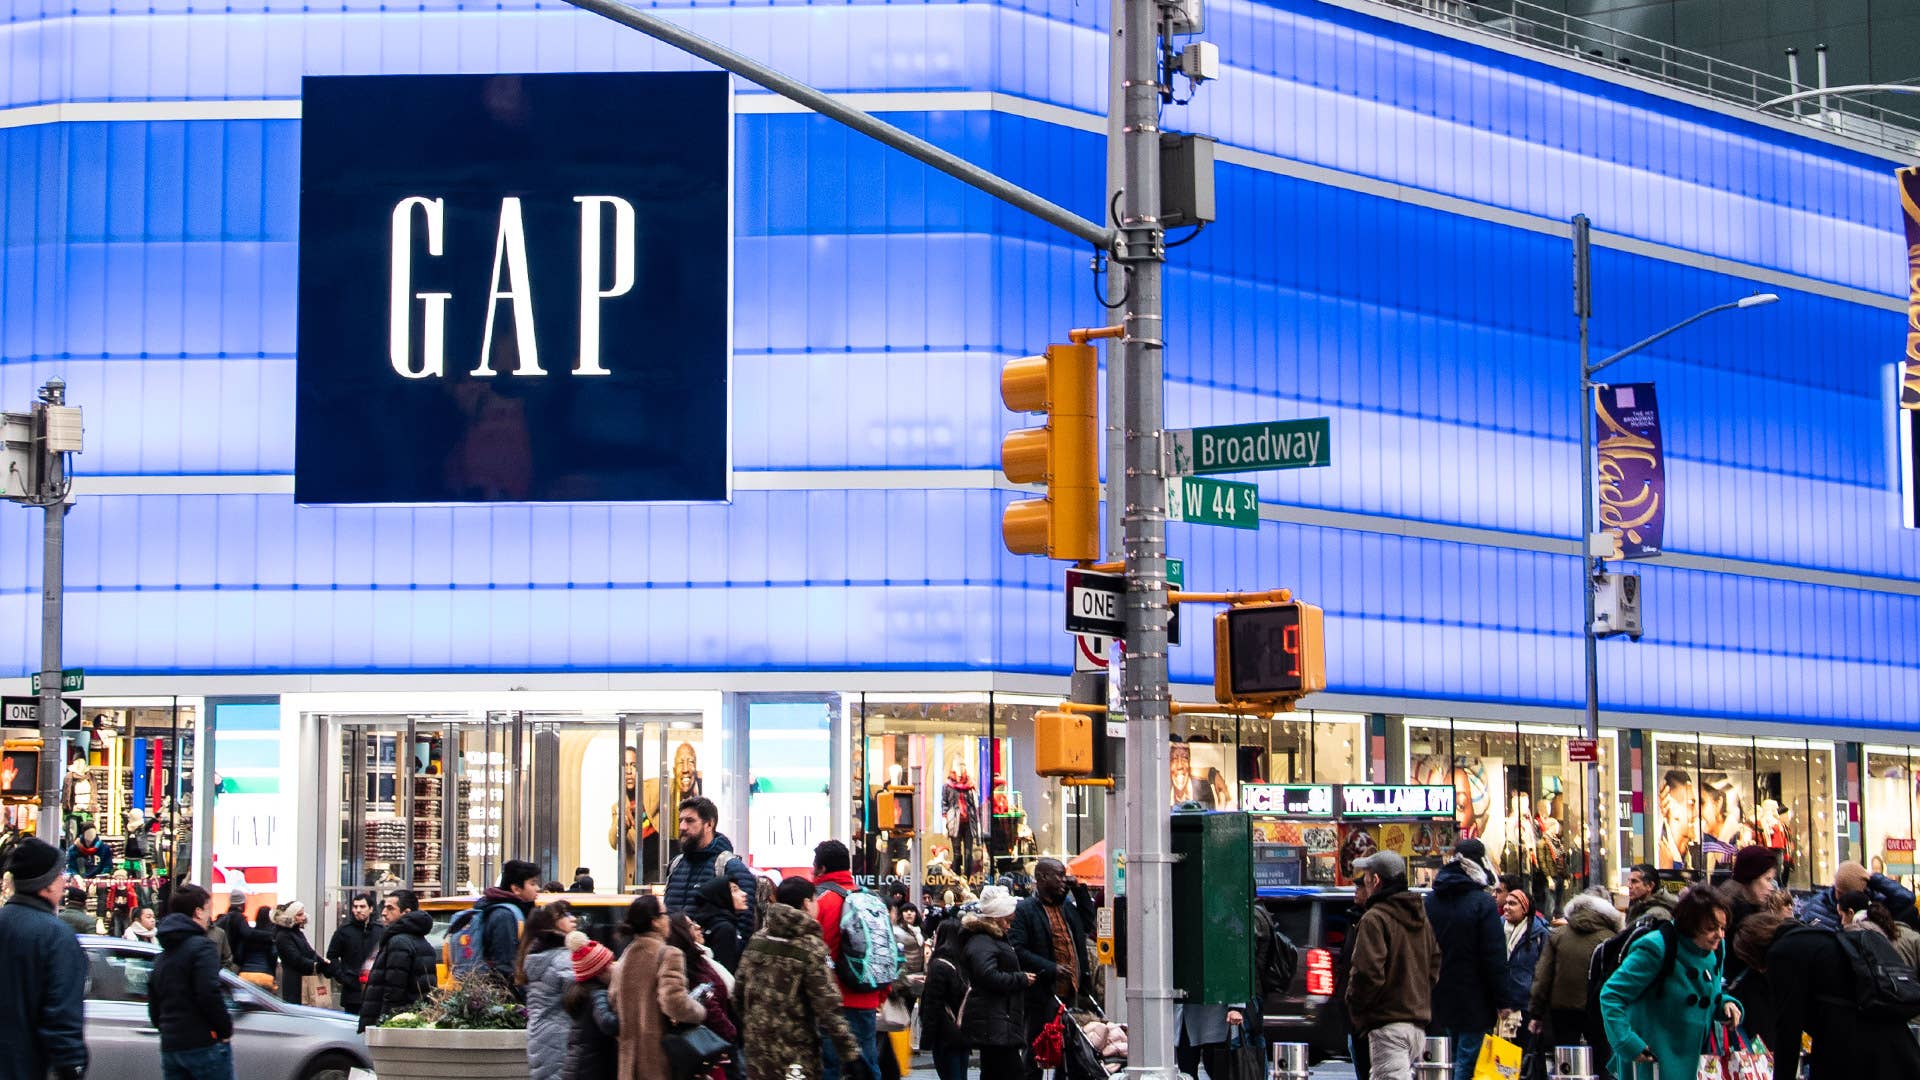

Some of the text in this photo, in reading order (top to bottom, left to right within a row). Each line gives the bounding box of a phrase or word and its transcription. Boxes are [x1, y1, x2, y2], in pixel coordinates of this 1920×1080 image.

[390, 194, 636, 380] GAP
[1202, 426, 1321, 467] Broadway
[1185, 482, 1257, 520] W 44 St
[1171, 562, 1180, 575] ST
[1082, 591, 1115, 618] ONE
[12, 706, 36, 719] ONE
[851, 874, 876, 886] IVE
